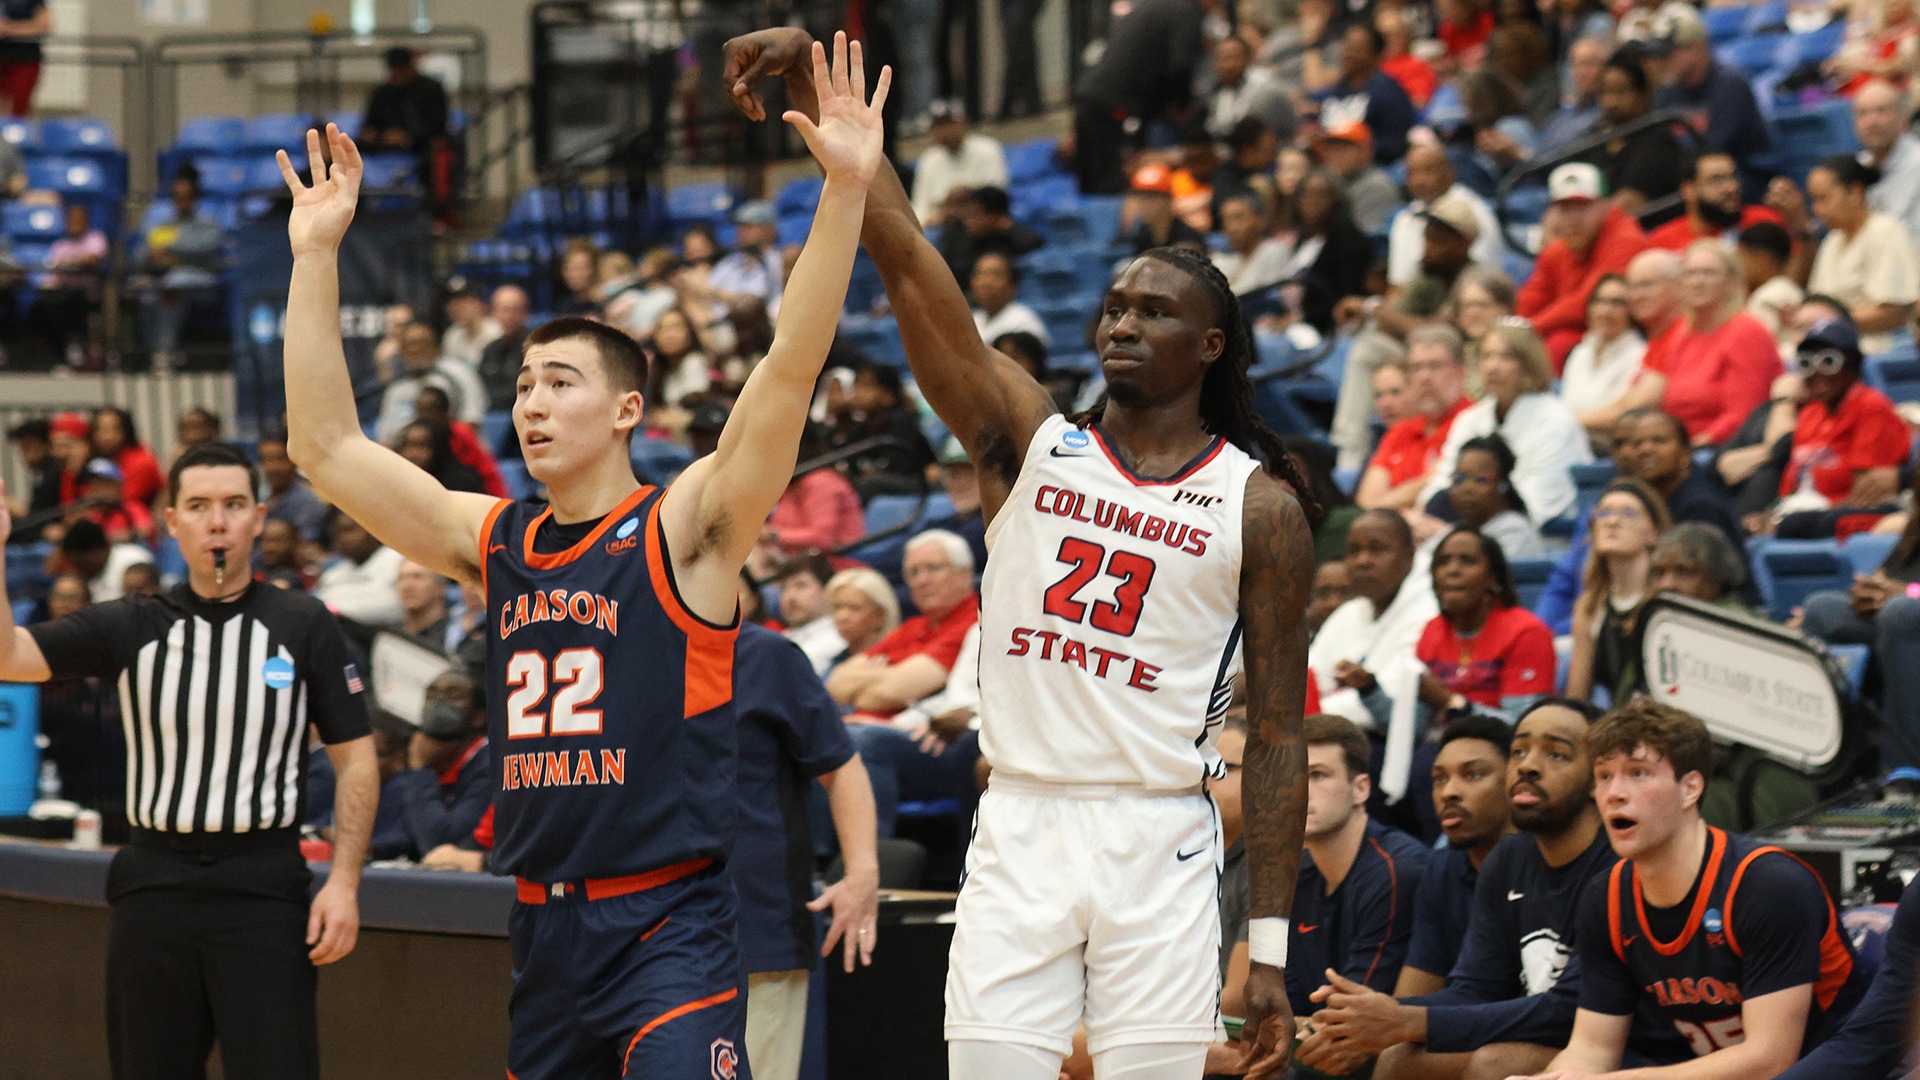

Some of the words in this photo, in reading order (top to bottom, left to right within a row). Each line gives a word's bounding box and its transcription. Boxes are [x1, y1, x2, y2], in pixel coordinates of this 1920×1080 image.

[1064, 436, 1088, 446] NCAA
[1035, 485, 1212, 557] COLUMBUS
[501, 589, 618, 640] CARSON
[1043, 536, 1156, 638] 23
[1006, 627, 1164, 693] STATE
[506, 646, 604, 740] 22
[502, 748, 626, 791] NEWMAN
[1645, 976, 1743, 1006] ARSON
